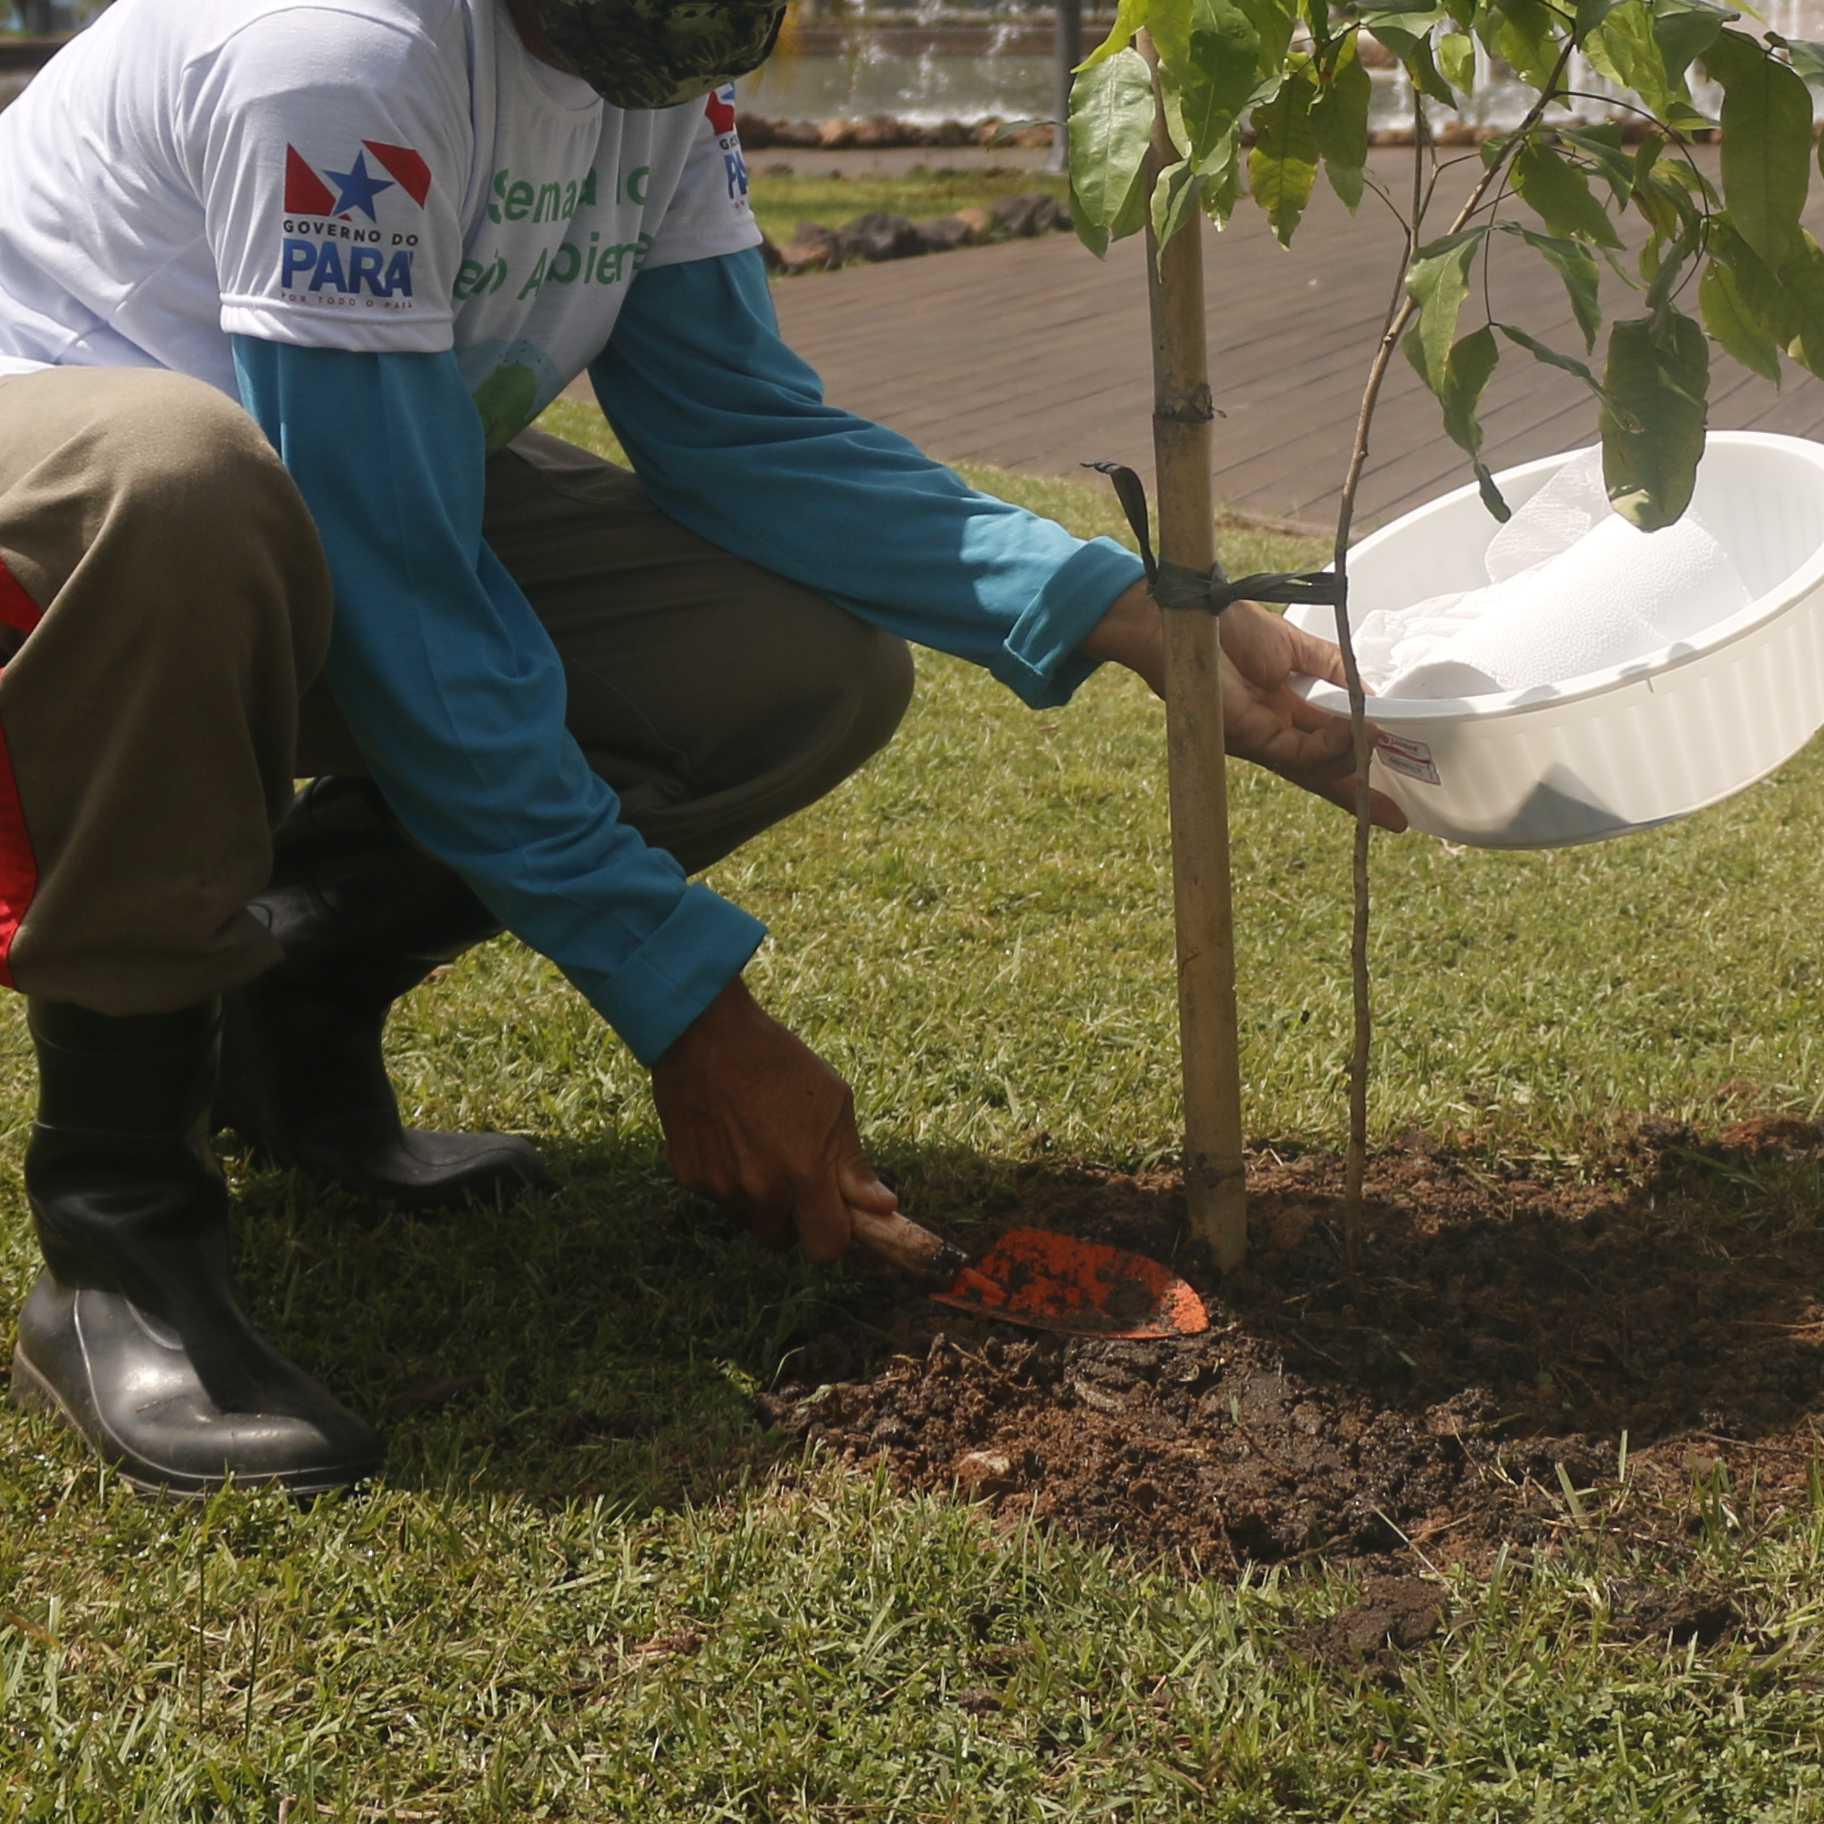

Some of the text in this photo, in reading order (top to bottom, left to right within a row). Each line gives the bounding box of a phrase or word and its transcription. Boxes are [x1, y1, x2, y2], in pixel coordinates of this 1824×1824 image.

[283, 219, 419, 247] GOVERNO DO
[281, 238, 414, 298] PARÁ
[318, 295, 357, 307] TODO
[366, 299, 374, 308] O
